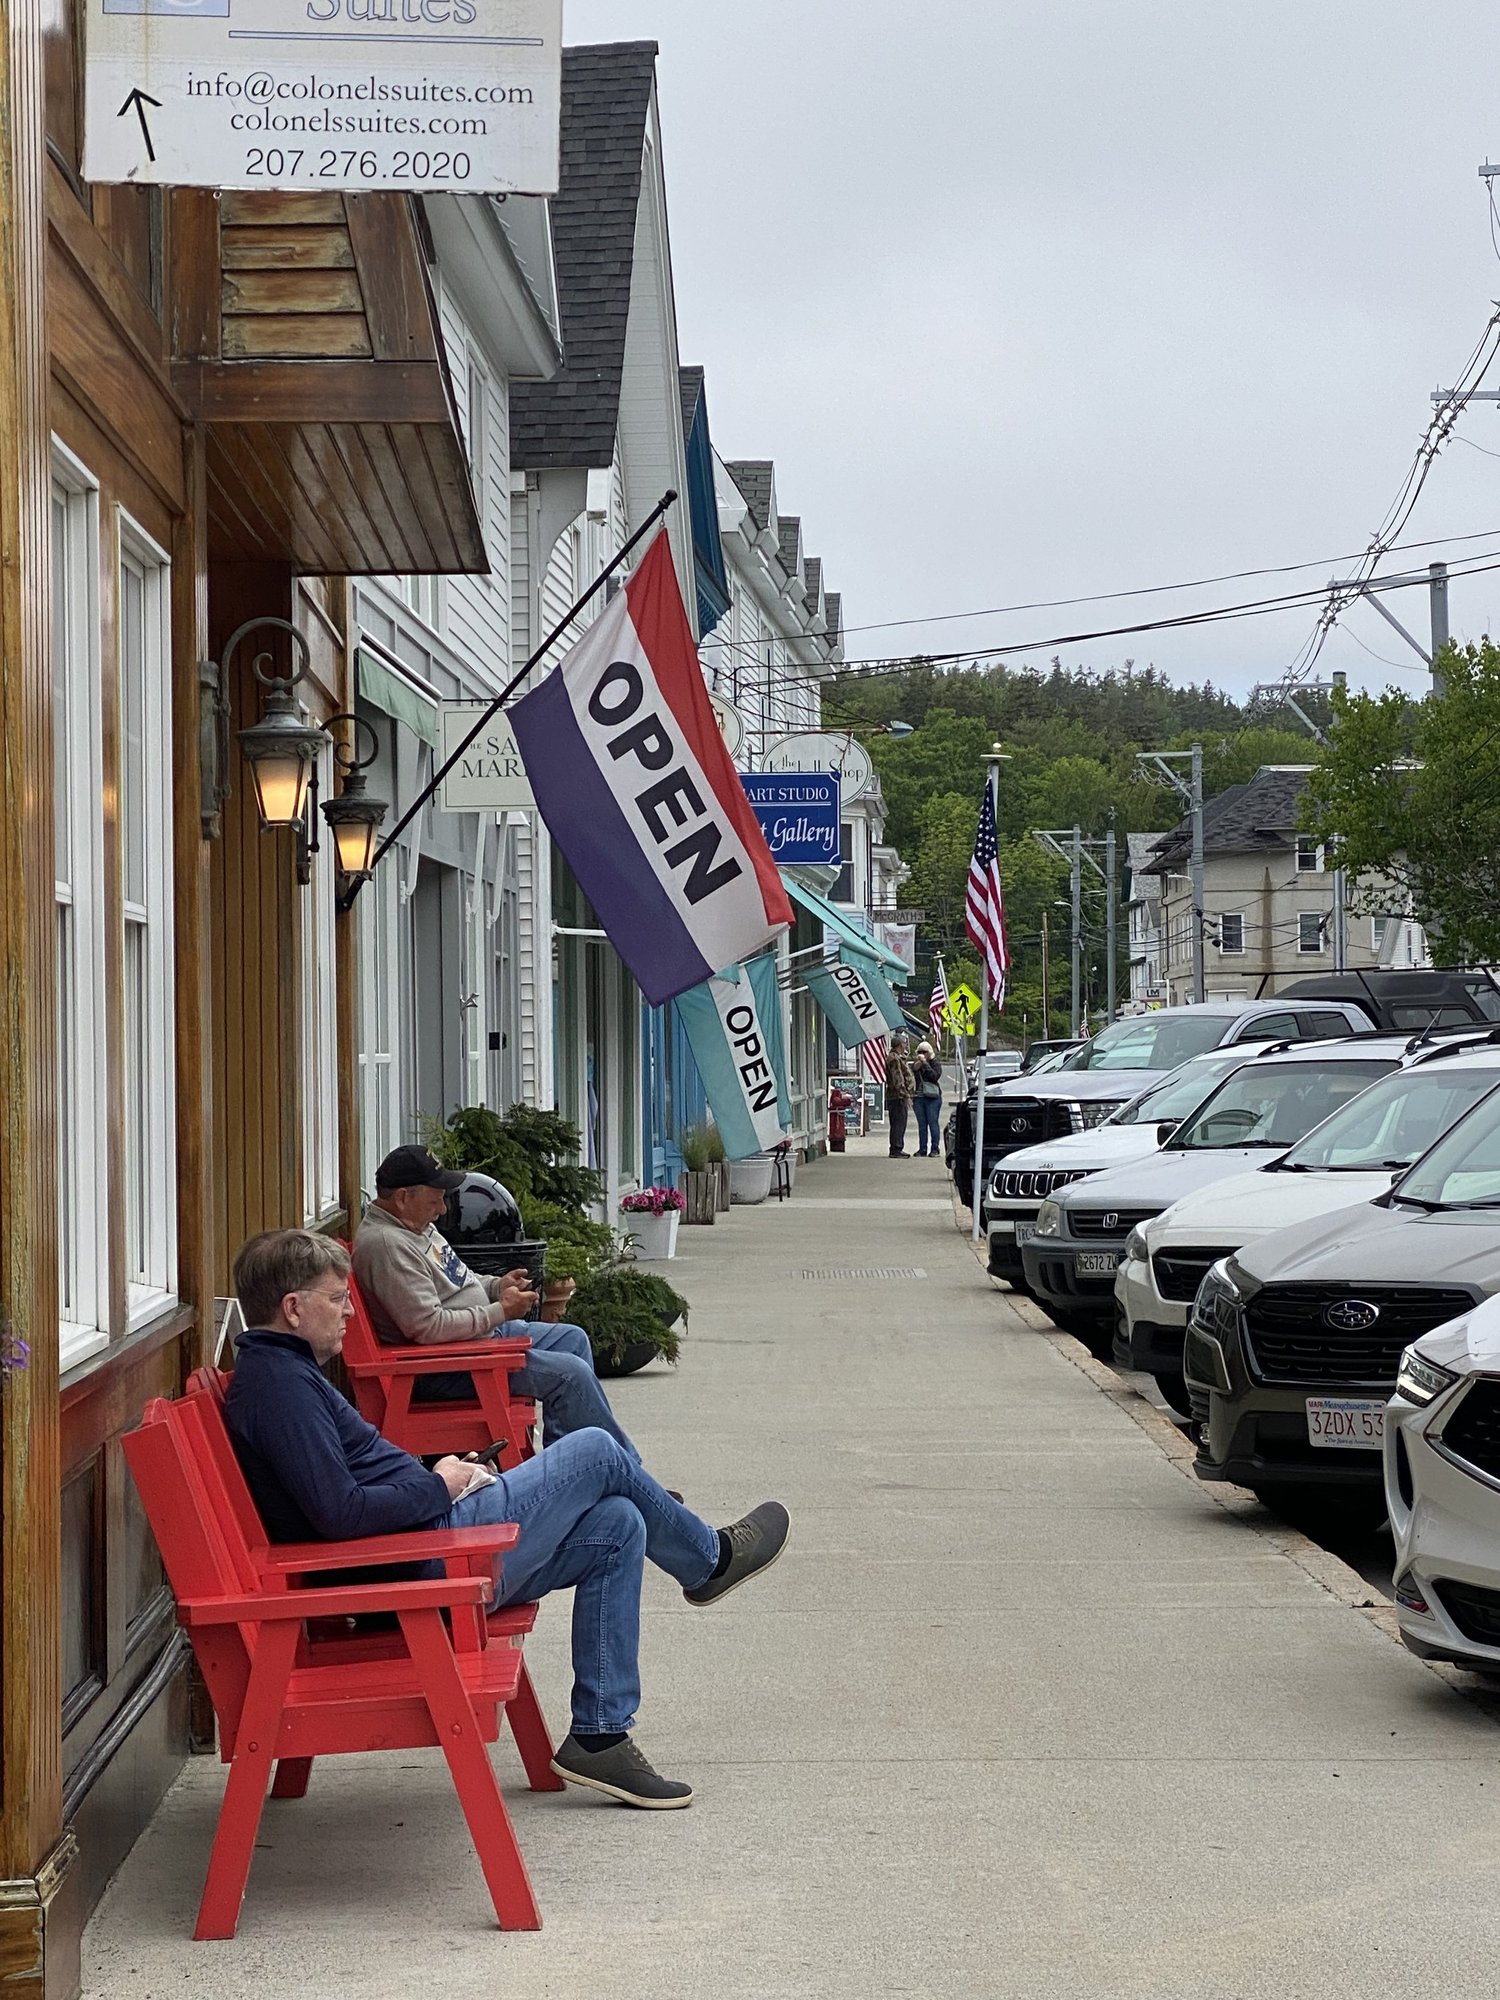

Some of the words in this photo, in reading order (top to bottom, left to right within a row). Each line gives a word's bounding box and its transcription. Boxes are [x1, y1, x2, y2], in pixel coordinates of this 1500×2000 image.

[186, 71, 534, 105] info@colonelssuites.com
[230, 106, 488, 135] colonelssuites.com
[245, 148, 471, 179] 207.276.2020
[486, 736, 518, 756] SA
[461, 758, 527, 778] MAR
[588, 661, 743, 906] OPEN
[746, 788, 776, 801] ART
[778, 787, 829, 801] STUDIO
[769, 817, 835, 852] Gallery
[834, 965, 878, 1020] OPEN
[726, 1005, 778, 1113] OPEN
[1084, 1255, 1104, 1270] 2672
[1311, 1411, 1356, 1435] 3ZDX
